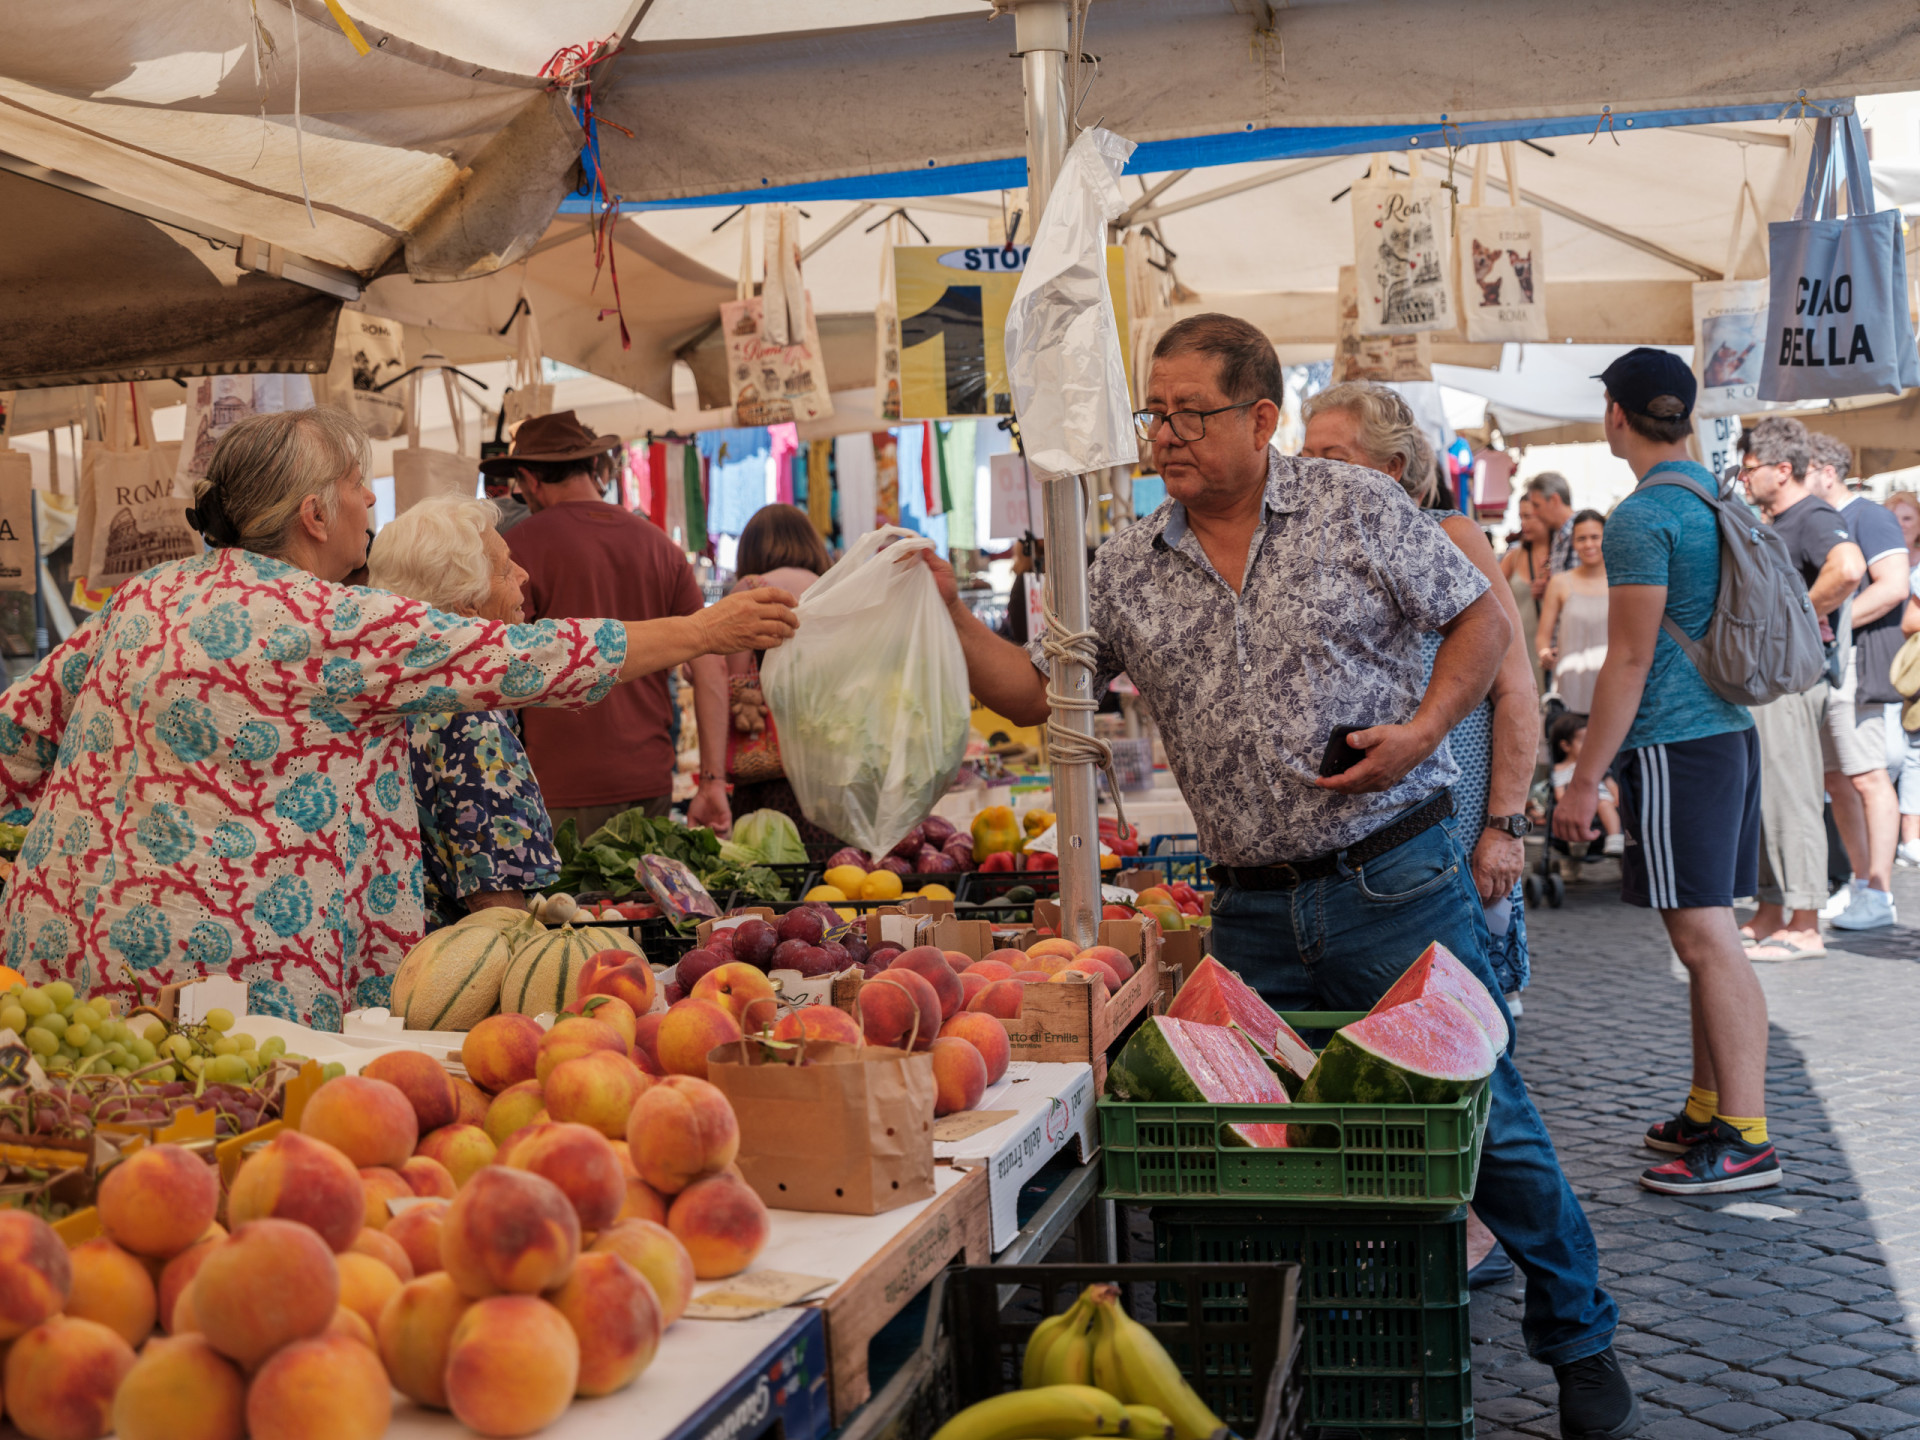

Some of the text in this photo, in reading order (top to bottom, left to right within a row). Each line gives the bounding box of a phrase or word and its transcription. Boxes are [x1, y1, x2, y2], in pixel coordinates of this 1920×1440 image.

[1795, 274, 1852, 316] CIAO
[1779, 323, 1875, 367] BELLA
[1044, 1032, 1079, 1044] Emilia
[1023, 1126, 1042, 1158] della
[998, 1143, 1024, 1180] Frutta
